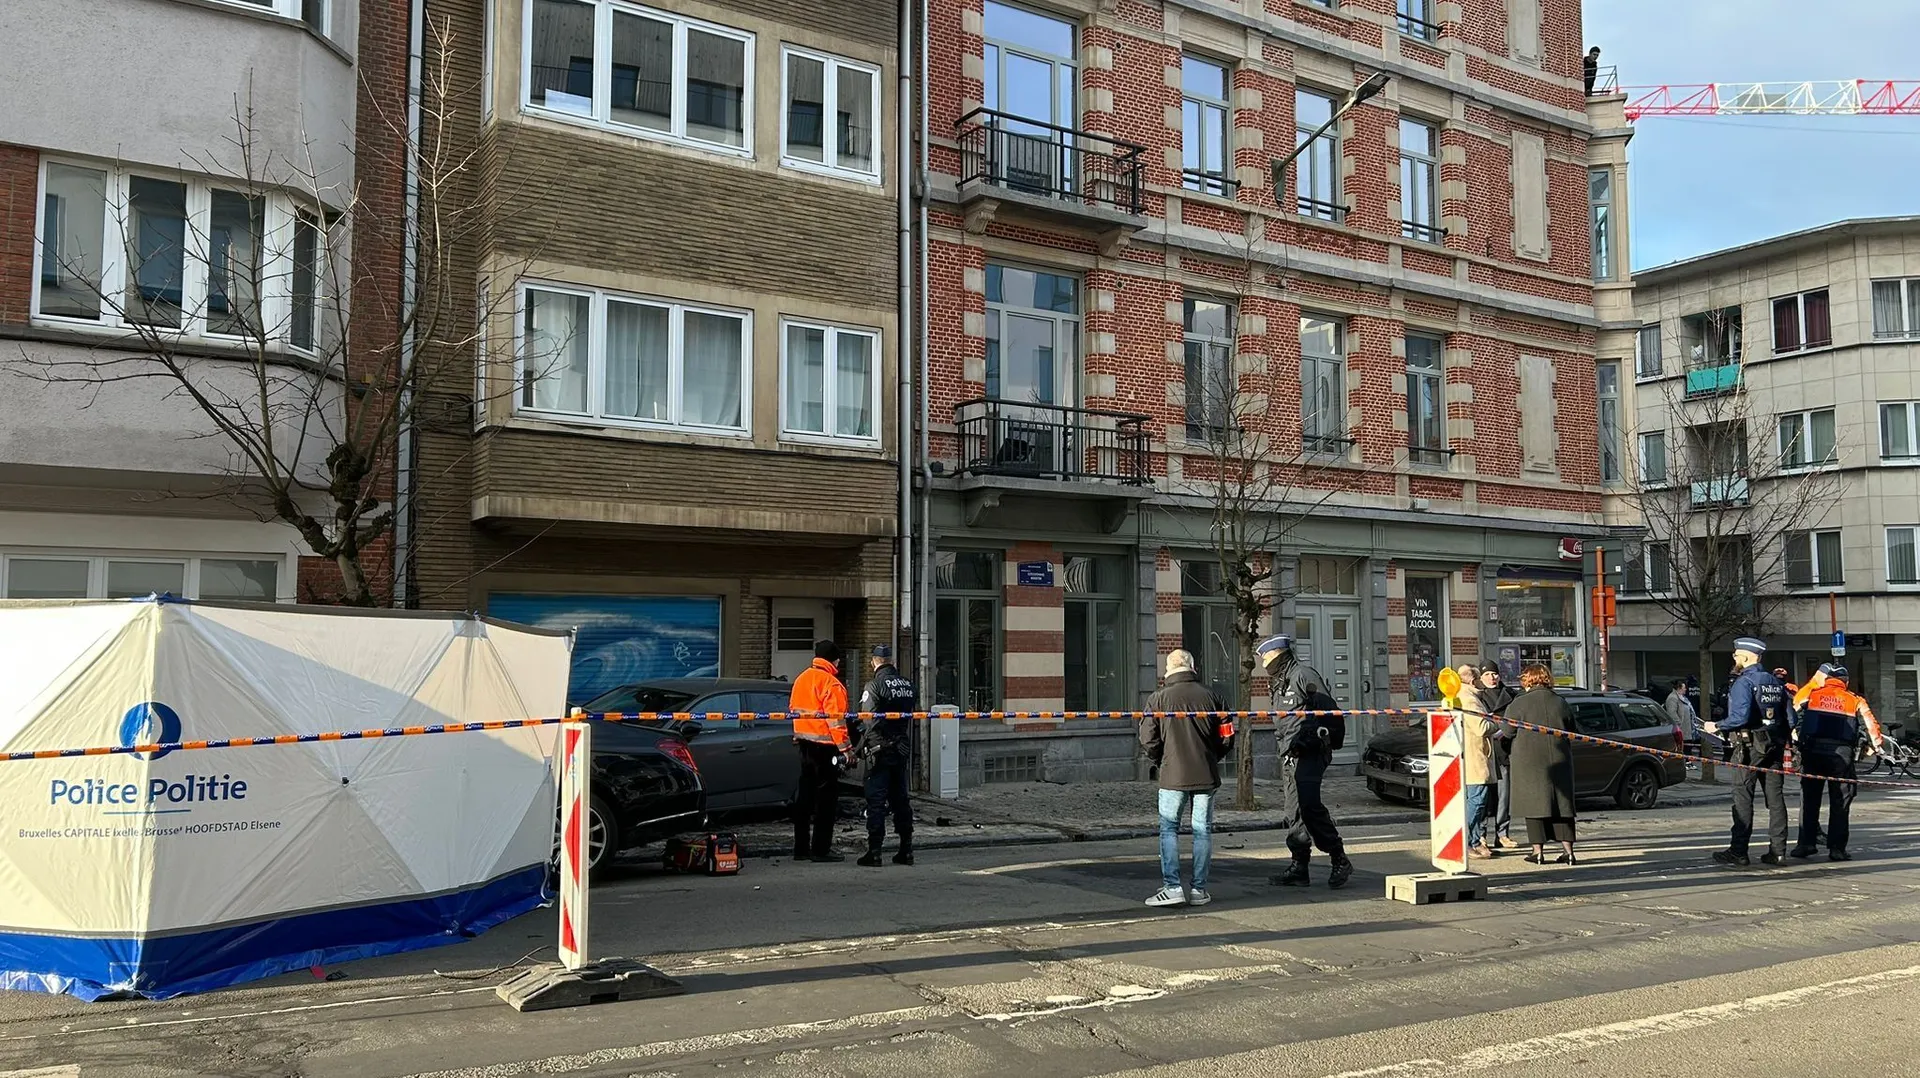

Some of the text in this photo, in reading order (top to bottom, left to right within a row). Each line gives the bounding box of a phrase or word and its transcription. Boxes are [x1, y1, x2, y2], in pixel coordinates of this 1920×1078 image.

[1415, 598, 1428, 607] VIN
[1411, 609, 1432, 619] TABAC
[1409, 619, 1436, 629] ALCOOL
[891, 687, 913, 698] Police
[1820, 701, 1844, 710] Police
[50, 774, 248, 805] Police Politie
[19, 828, 61, 838] Bruxelles
[64, 828, 110, 838] CAPITALE
[113, 827, 139, 838] Ixelle
[185, 821, 248, 834] HOOFDSTAD
[250, 820, 281, 831] Elsene
